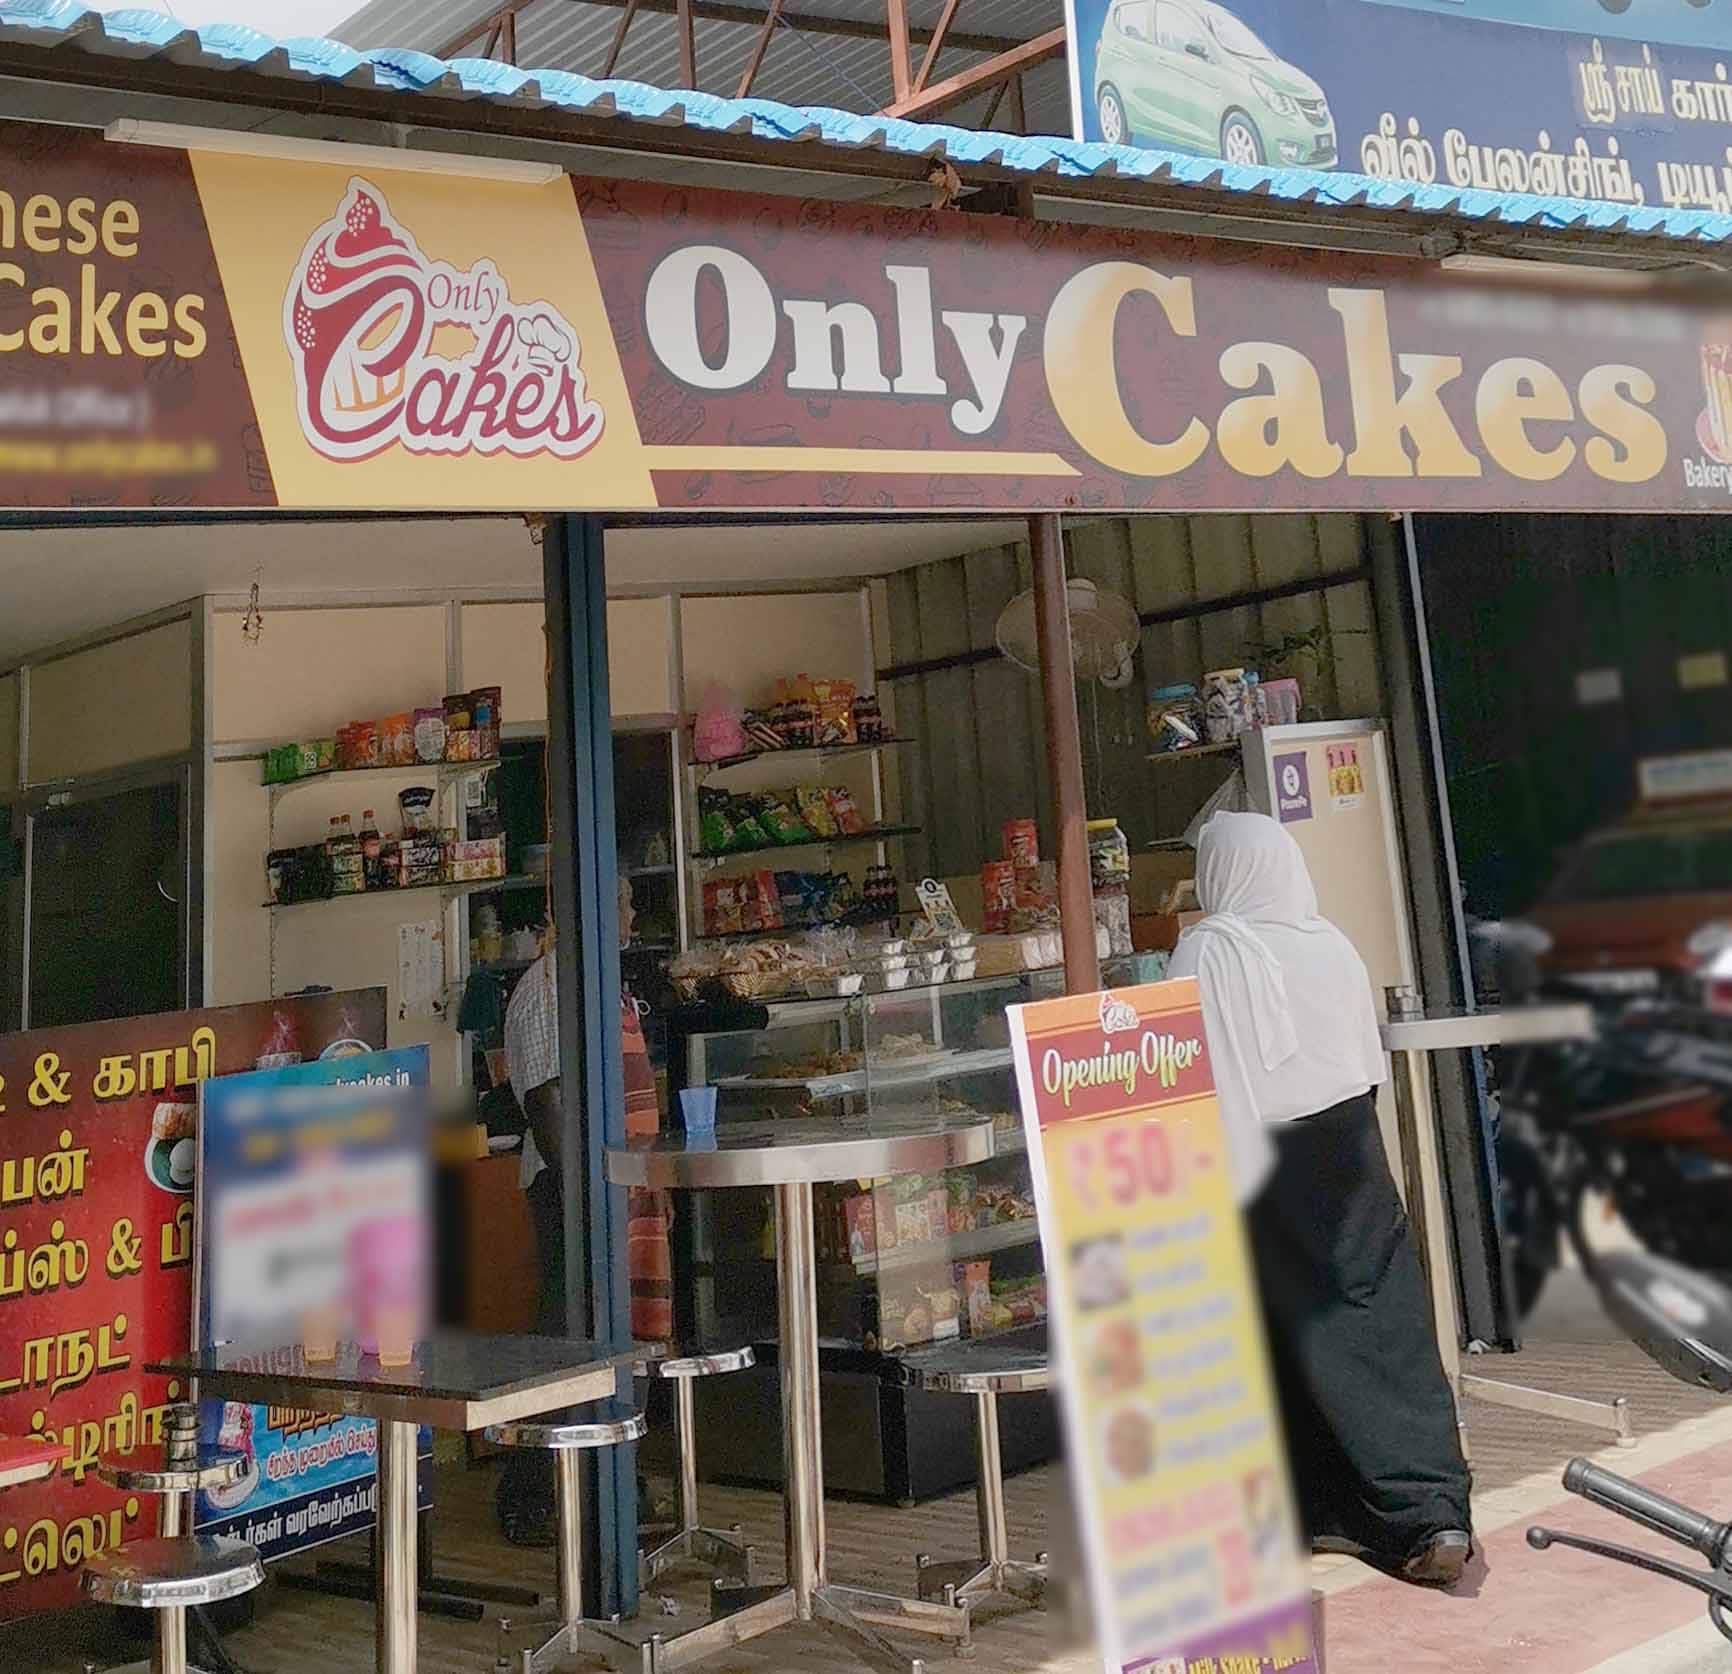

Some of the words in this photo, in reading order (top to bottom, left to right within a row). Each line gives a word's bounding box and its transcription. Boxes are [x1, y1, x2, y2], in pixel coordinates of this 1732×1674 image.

[1361, 112, 1436, 183] வீல்
[427, 270, 500, 324] Only
[300, 272, 597, 444] Cakes
[645, 245, 1026, 434] Only
[1044, 261, 1667, 482] Cakes
[28, 1053, 72, 1106] &
[93, 1027, 217, 1097] காபி
[1042, 1041, 1139, 1107] Opening
[1141, 1031, 1202, 1088] Offer
[106, 1218, 143, 1274] &
